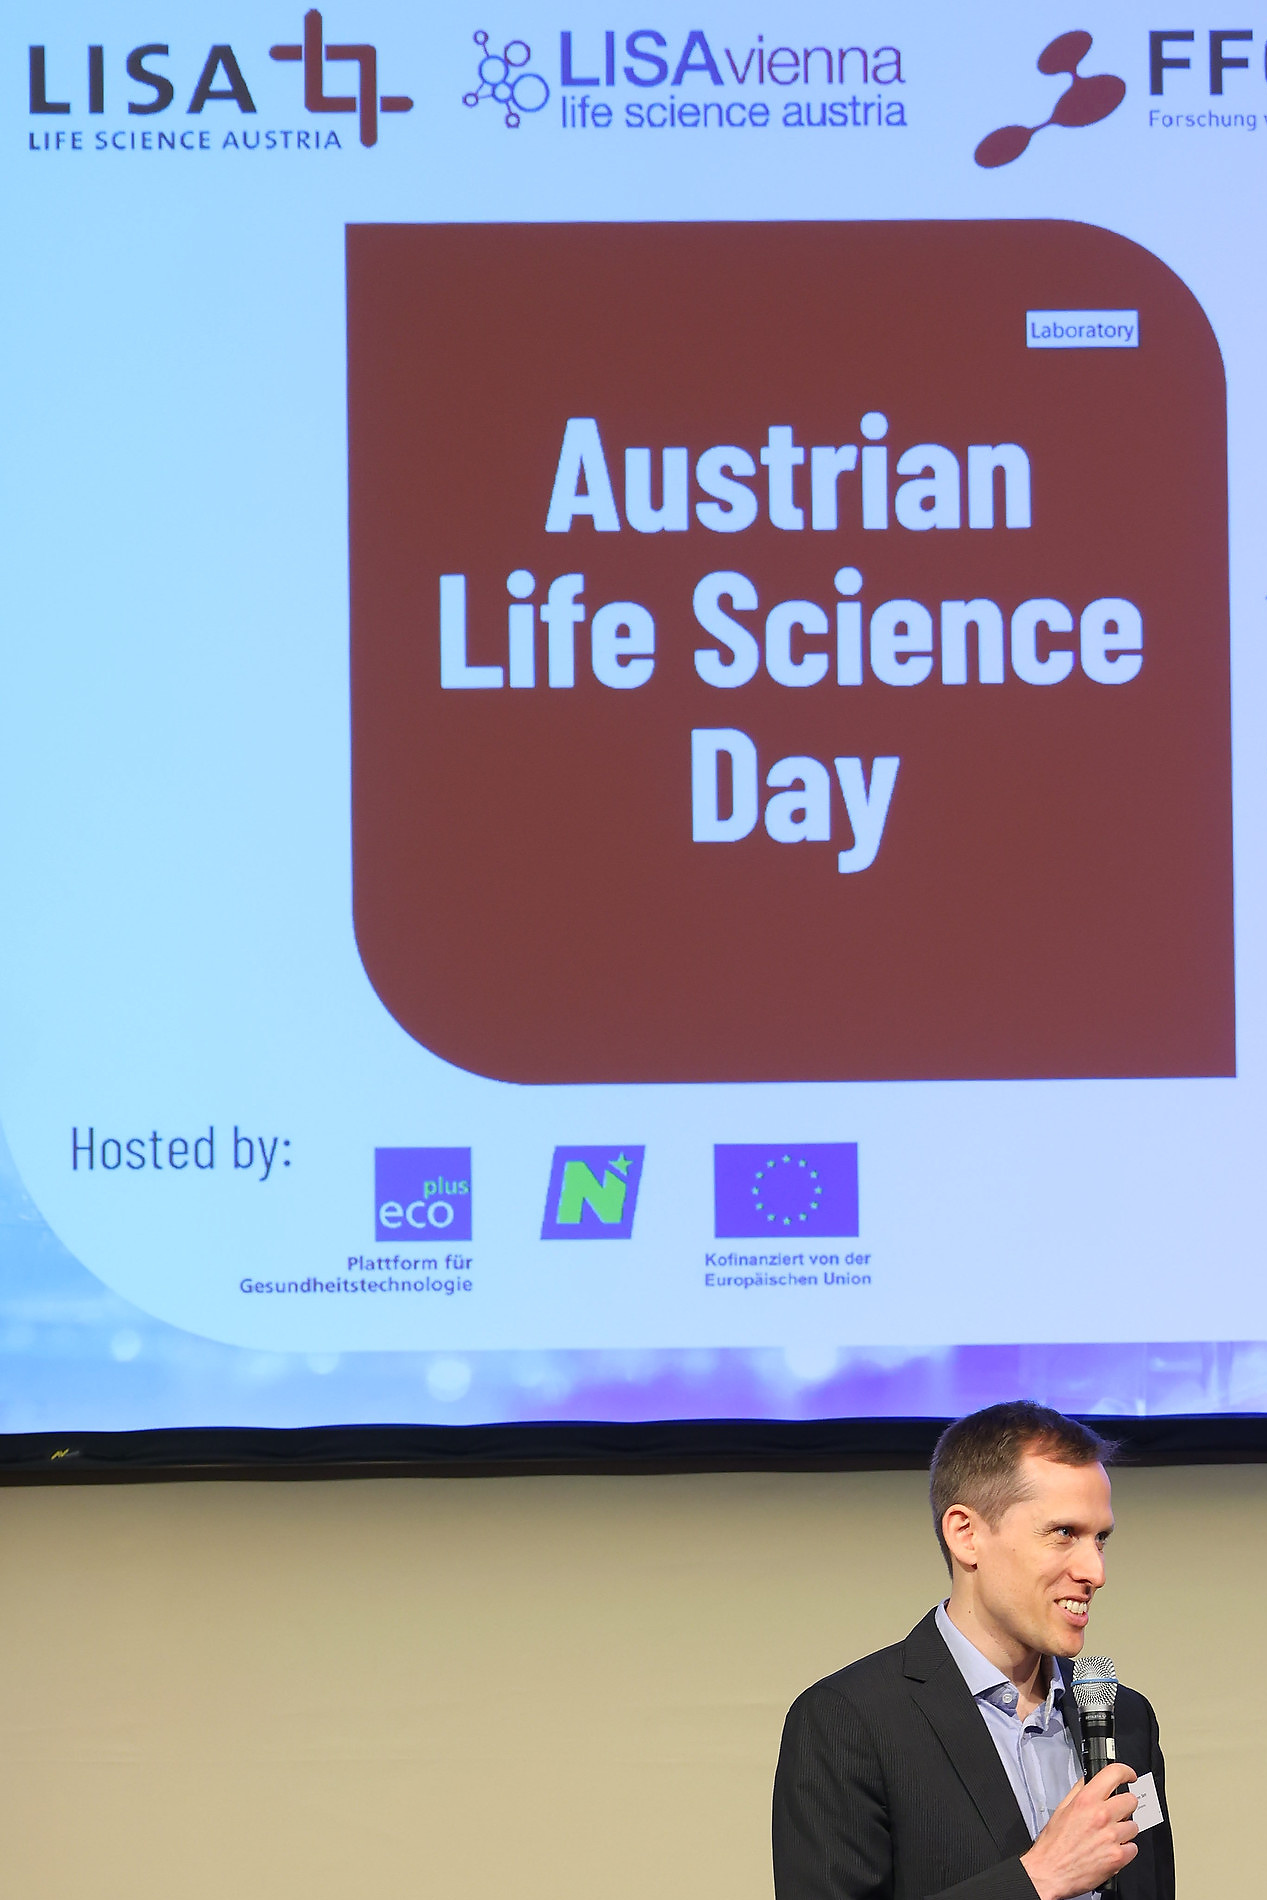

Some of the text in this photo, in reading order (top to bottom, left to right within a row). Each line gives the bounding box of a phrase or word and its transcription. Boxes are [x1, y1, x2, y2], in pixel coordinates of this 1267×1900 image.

[560, 30, 906, 87] LISAvienna
[29, 44, 257, 115] LISA
[562, 94, 907, 128] life science austria
[1149, 110, 1257, 131] Forschung
[29, 130, 341, 150] LIFE SCIENCE AUSTRIA
[1031, 322, 1134, 341] Laboratory
[545, 411, 1031, 533] Austrian
[440, 566, 1143, 689] Life Science
[691, 728, 900, 873] Day
[73, 1126, 290, 1181] Hosted by:
[424, 1177, 469, 1197] plus
[379, 1200, 454, 1229] eco
[348, 1255, 473, 1271] Plattform für
[705, 1252, 871, 1266] Kofinanziert von der
[240, 1277, 473, 1295] Gesundheitstechnologie
[705, 1272, 871, 1289] Europäischen Union
